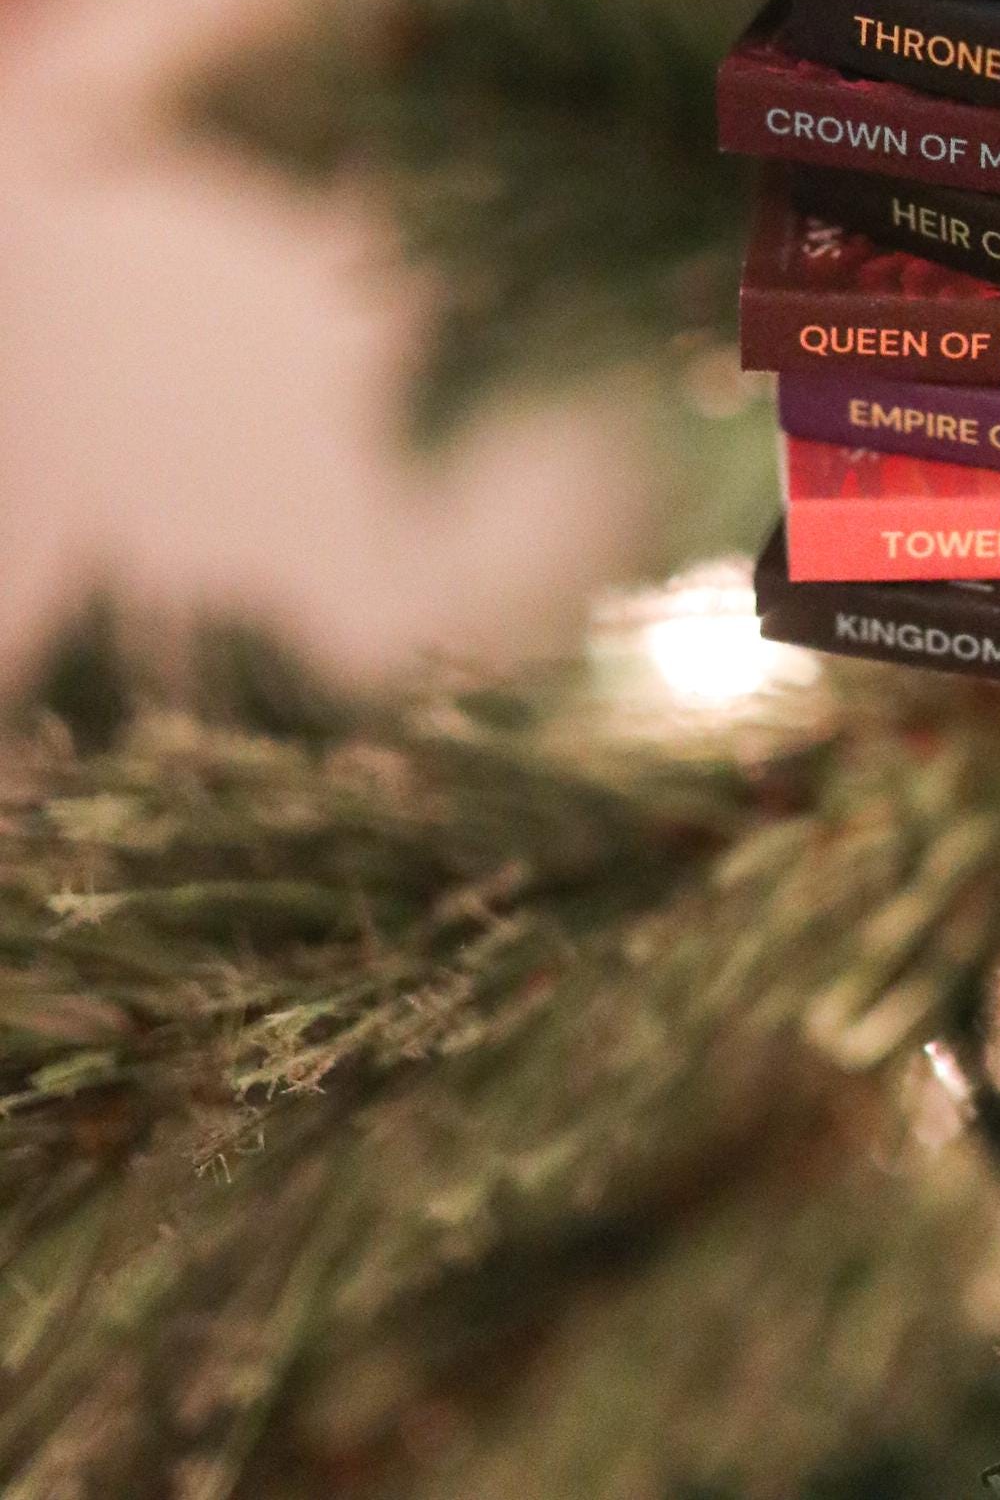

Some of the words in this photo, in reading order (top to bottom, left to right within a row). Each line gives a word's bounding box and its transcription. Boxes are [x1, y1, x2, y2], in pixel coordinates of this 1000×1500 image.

[767, 108, 907, 155] CROWN
[920, 134, 967, 164] OF
[893, 198, 971, 250] HEIR
[800, 326, 927, 356] QUEEN
[940, 331, 991, 360] OF
[849, 399, 978, 445] EMPIRE
